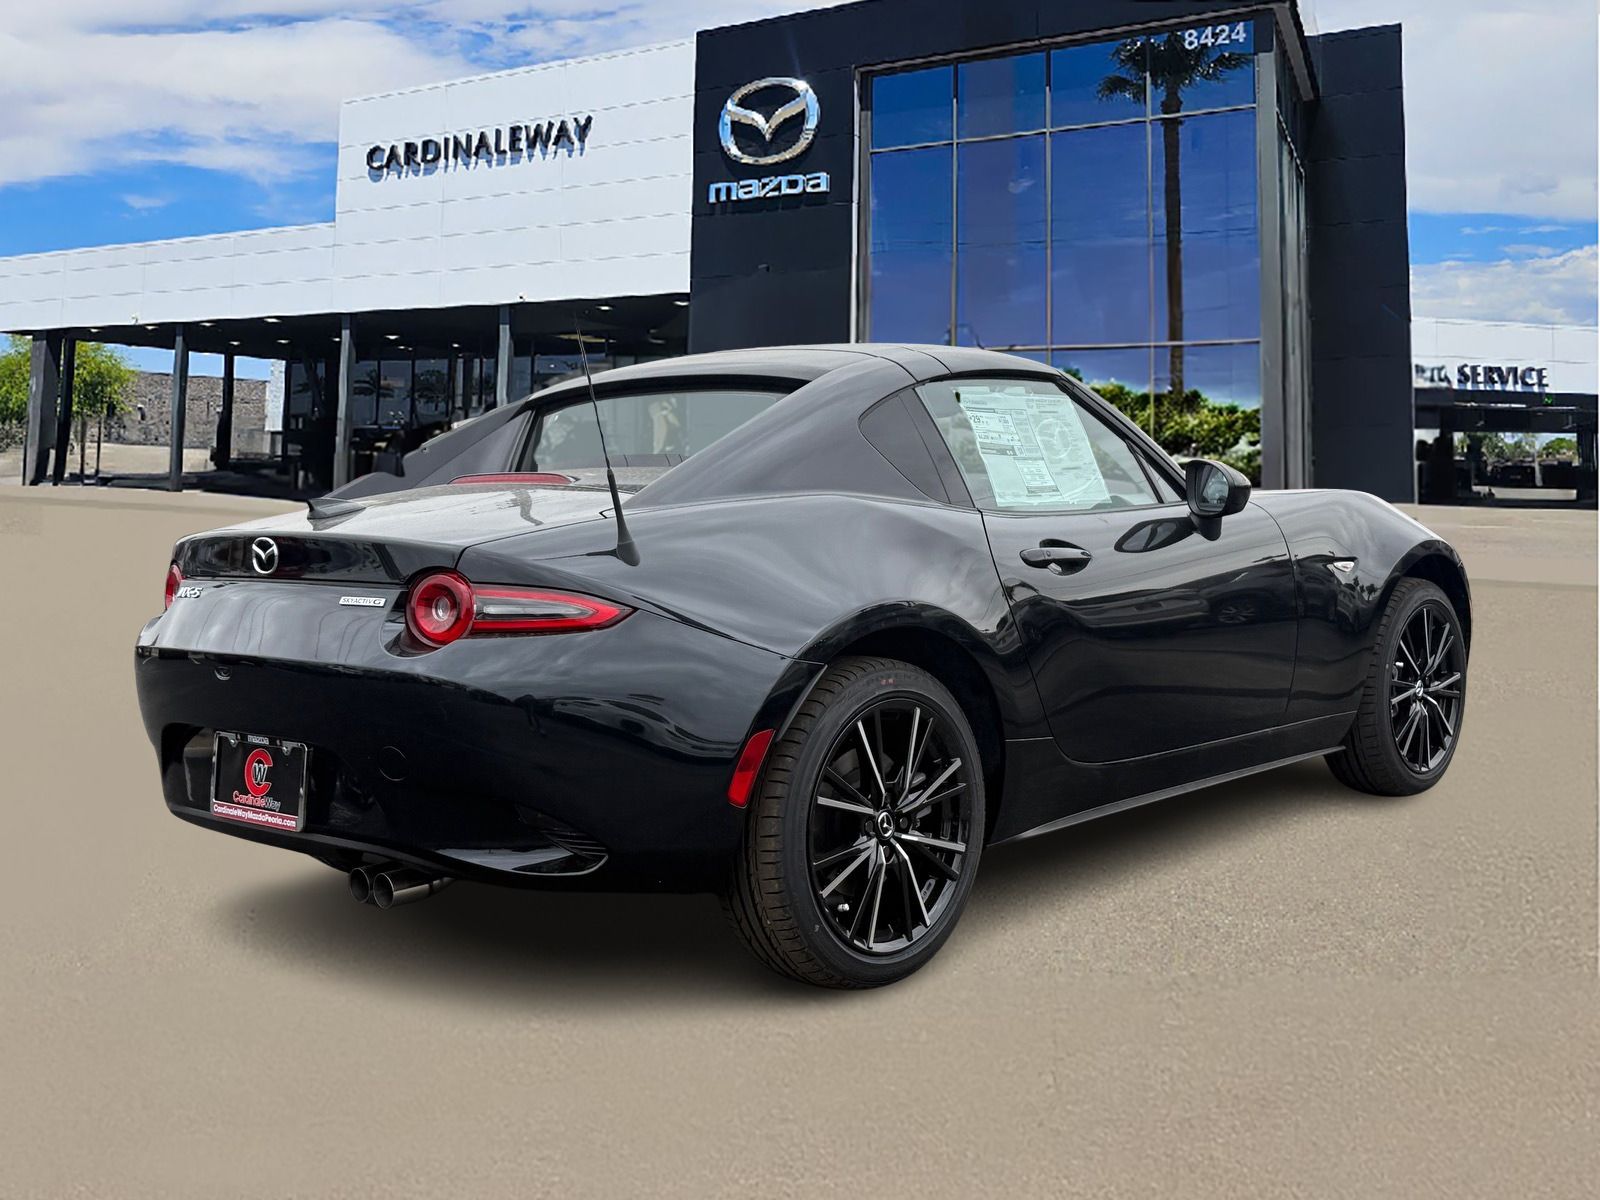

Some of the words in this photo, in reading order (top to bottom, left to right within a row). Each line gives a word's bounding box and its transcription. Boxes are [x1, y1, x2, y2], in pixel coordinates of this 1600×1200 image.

[1184, 21, 1247, 50] 8424
[366, 115, 593, 170] CARDINALEWAY
[708, 171, 830, 204] mazda
[1457, 363, 1549, 388] SERVICE
